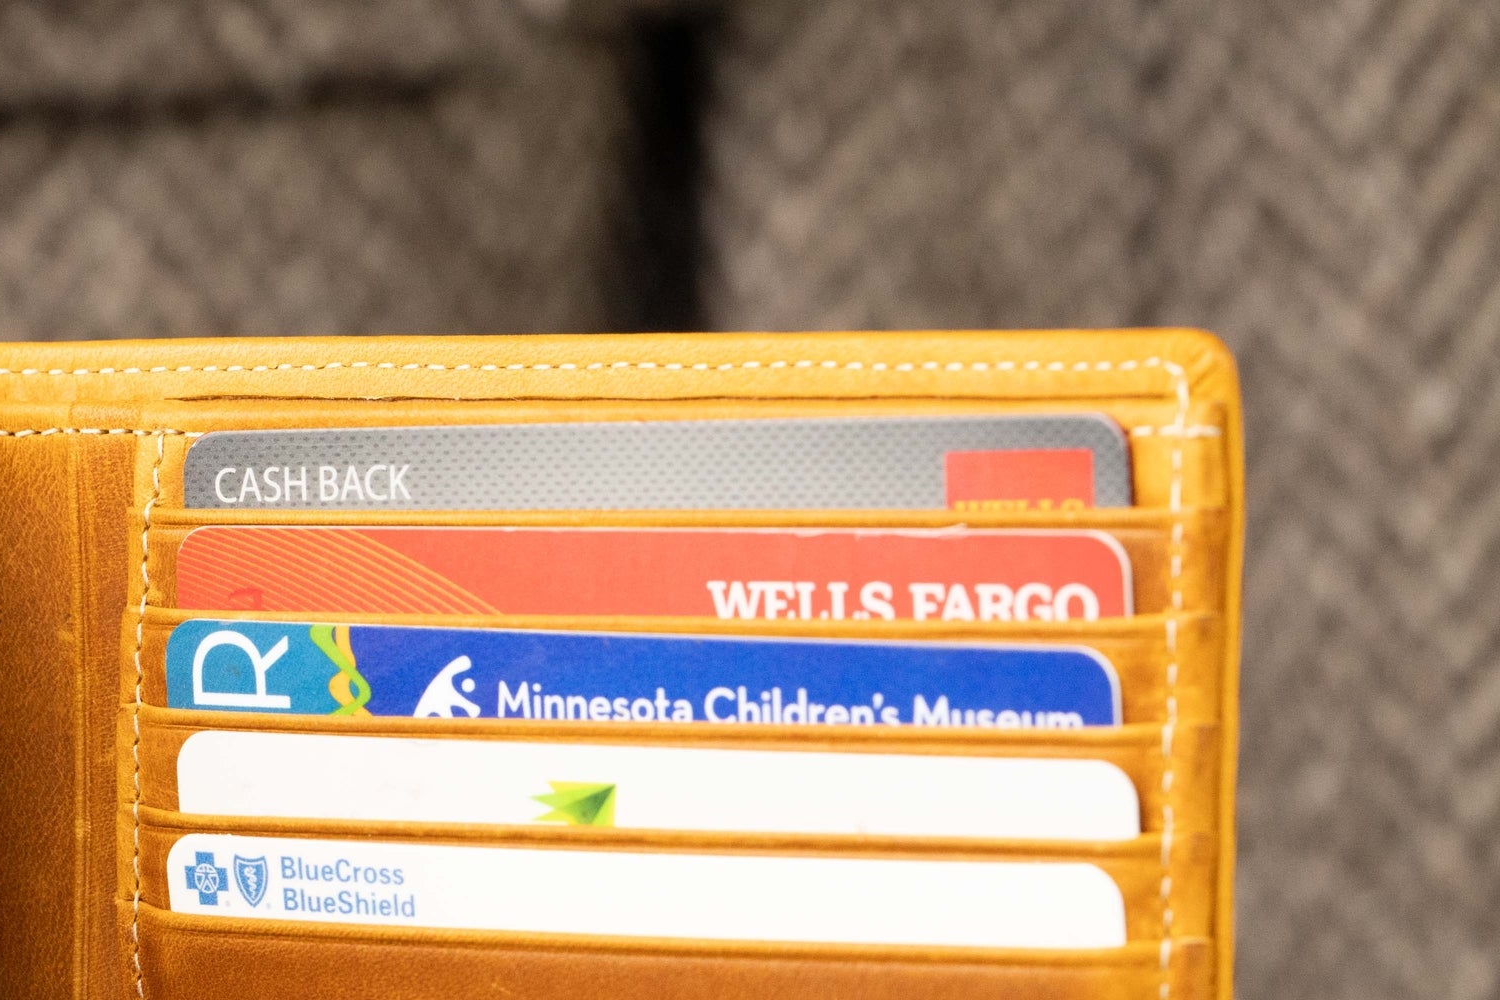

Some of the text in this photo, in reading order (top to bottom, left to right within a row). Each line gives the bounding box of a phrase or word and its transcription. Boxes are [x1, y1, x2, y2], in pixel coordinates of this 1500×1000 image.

[215, 464, 412, 503] CASH BACK
[706, 580, 1101, 621] WELLS FARGO
[193, 630, 291, 709] R
[498, 680, 1085, 729] Minnesota Children's Museum
[280, 856, 405, 886] BlueCross
[283, 887, 416, 918] BlueShield
